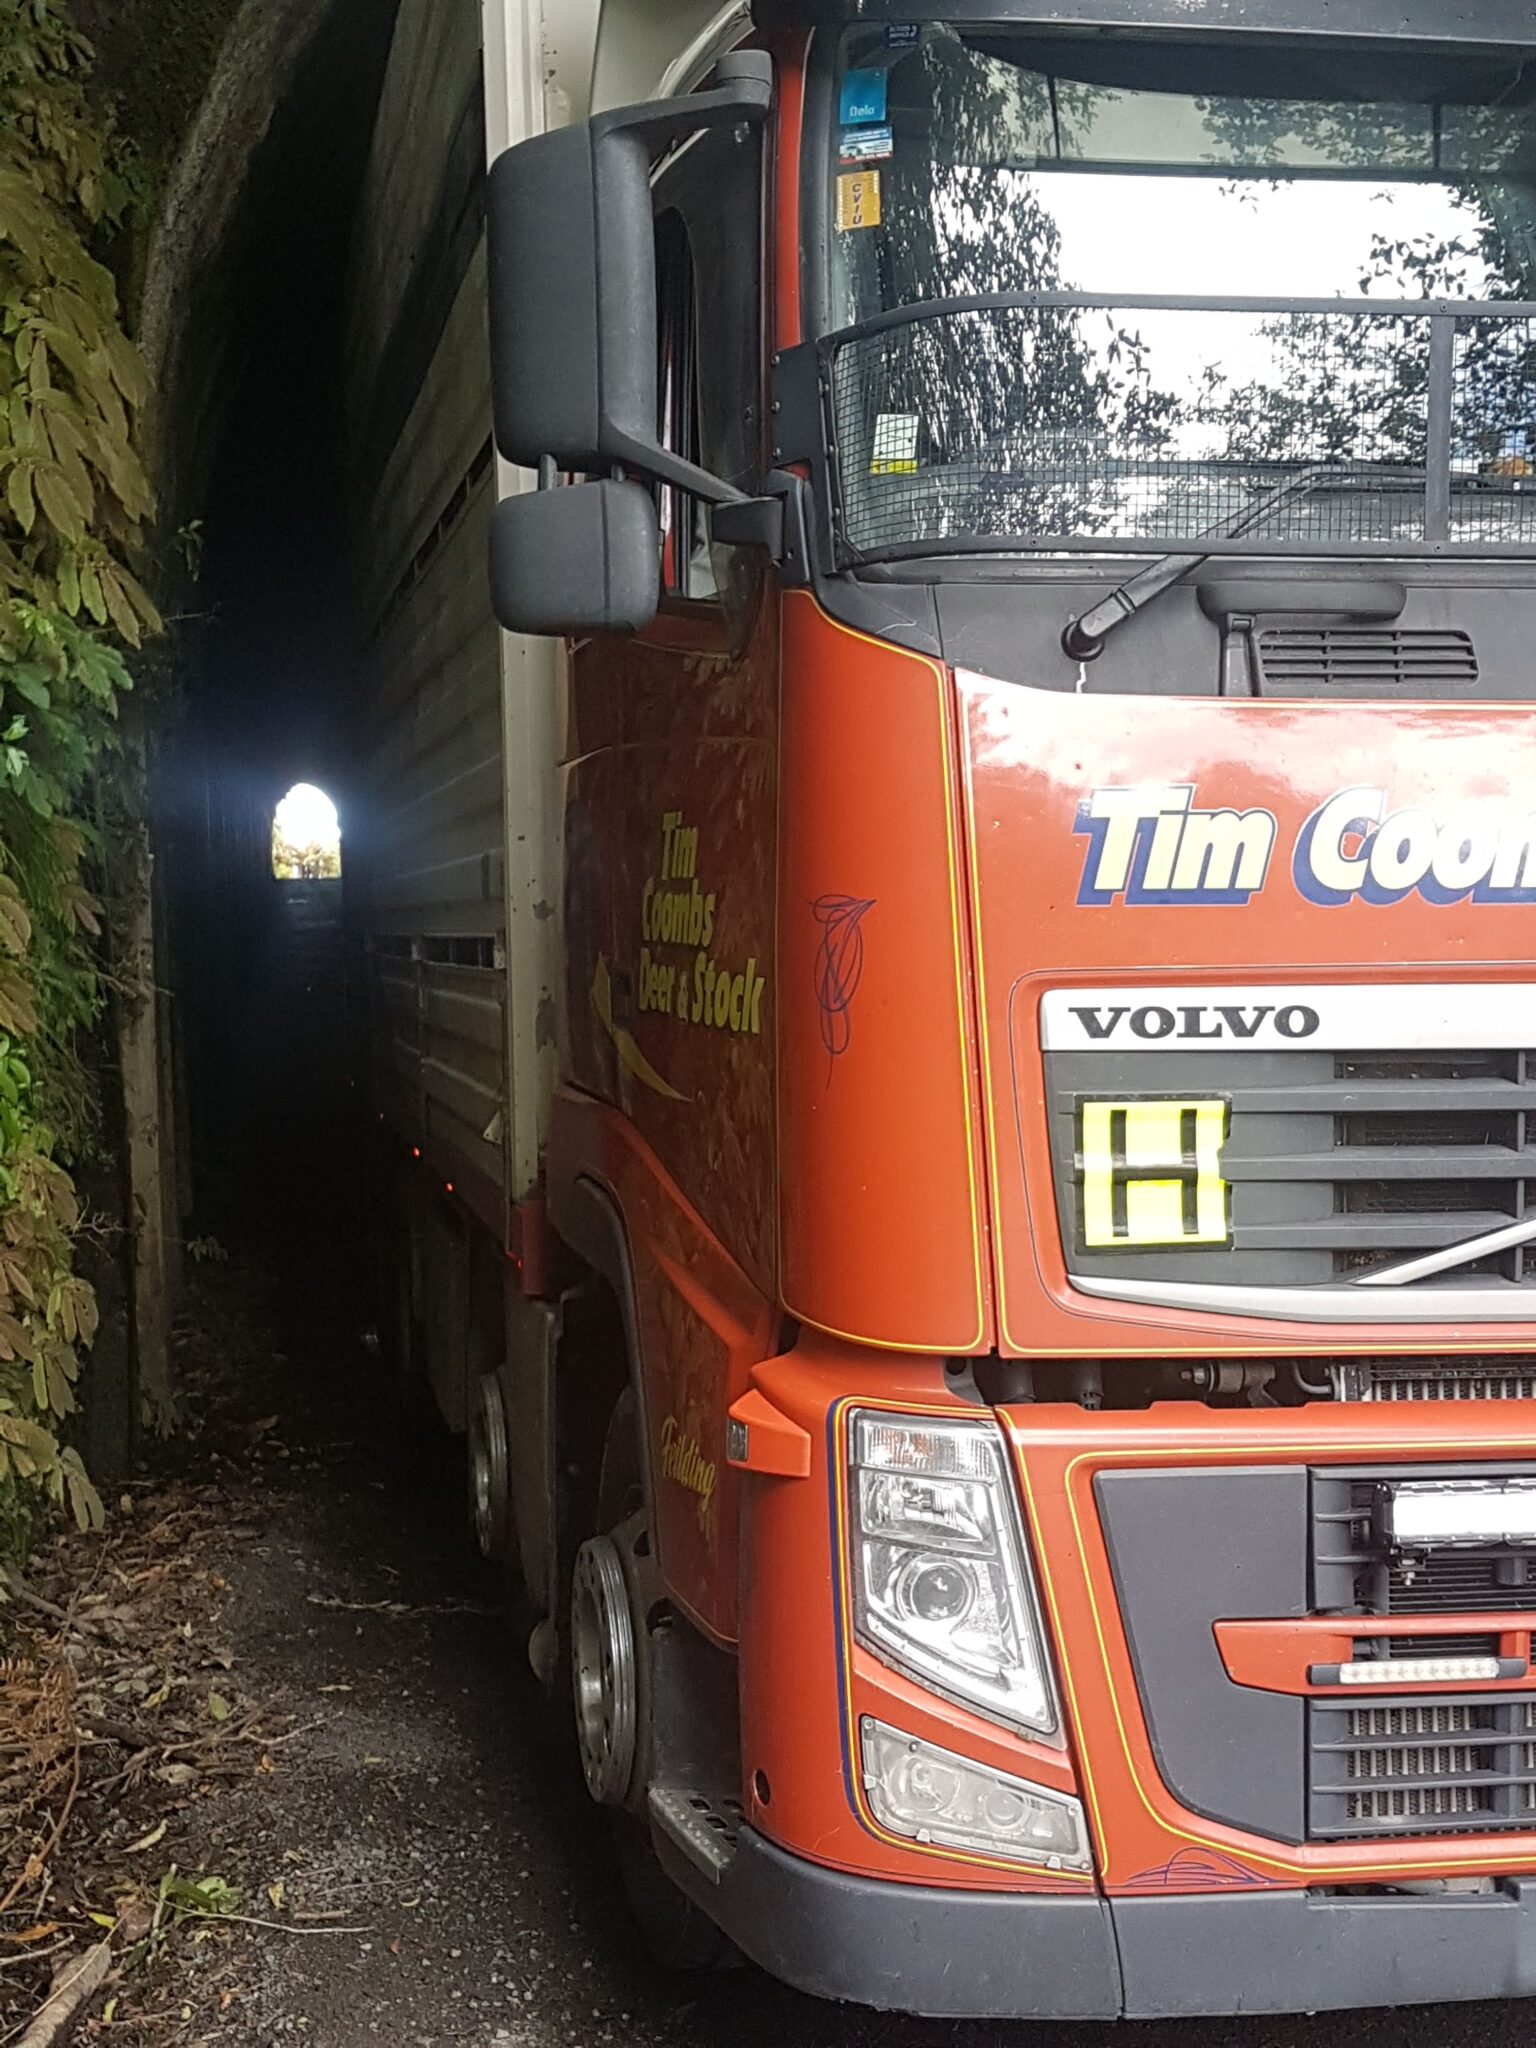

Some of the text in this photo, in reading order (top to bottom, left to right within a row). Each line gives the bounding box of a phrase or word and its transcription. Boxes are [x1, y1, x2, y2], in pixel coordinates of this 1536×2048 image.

[850, 105, 875, 117] Delo
[852, 183, 863, 225] CVIU
[662, 811, 698, 880] Tim
[1072, 784, 1275, 906] Tim
[642, 877, 716, 947] Coombs
[639, 947, 676, 1013] Deer
[692, 951, 766, 1034] Stock
[1068, 1005, 1320, 1039] VOLVO
[1109, 1109, 1199, 1238] H
